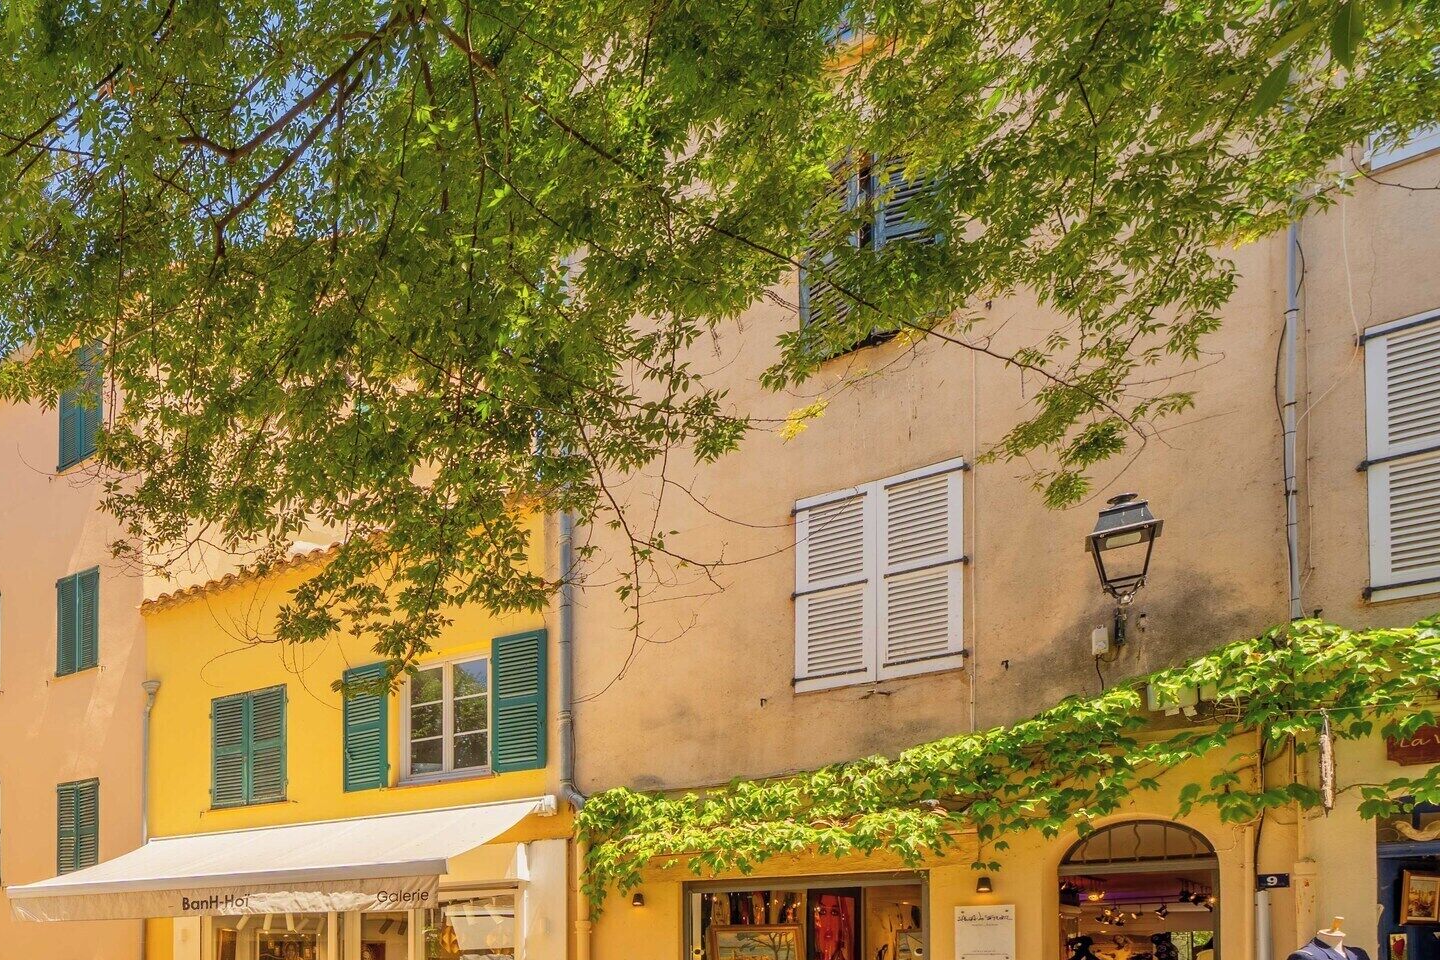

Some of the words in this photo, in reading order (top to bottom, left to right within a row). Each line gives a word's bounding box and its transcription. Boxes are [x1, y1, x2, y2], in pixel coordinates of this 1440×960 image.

[1266, 876, 1278, 886] 9
[182, 893, 251, 911] BanH-Hoï
[376, 888, 429, 903] Galerie
